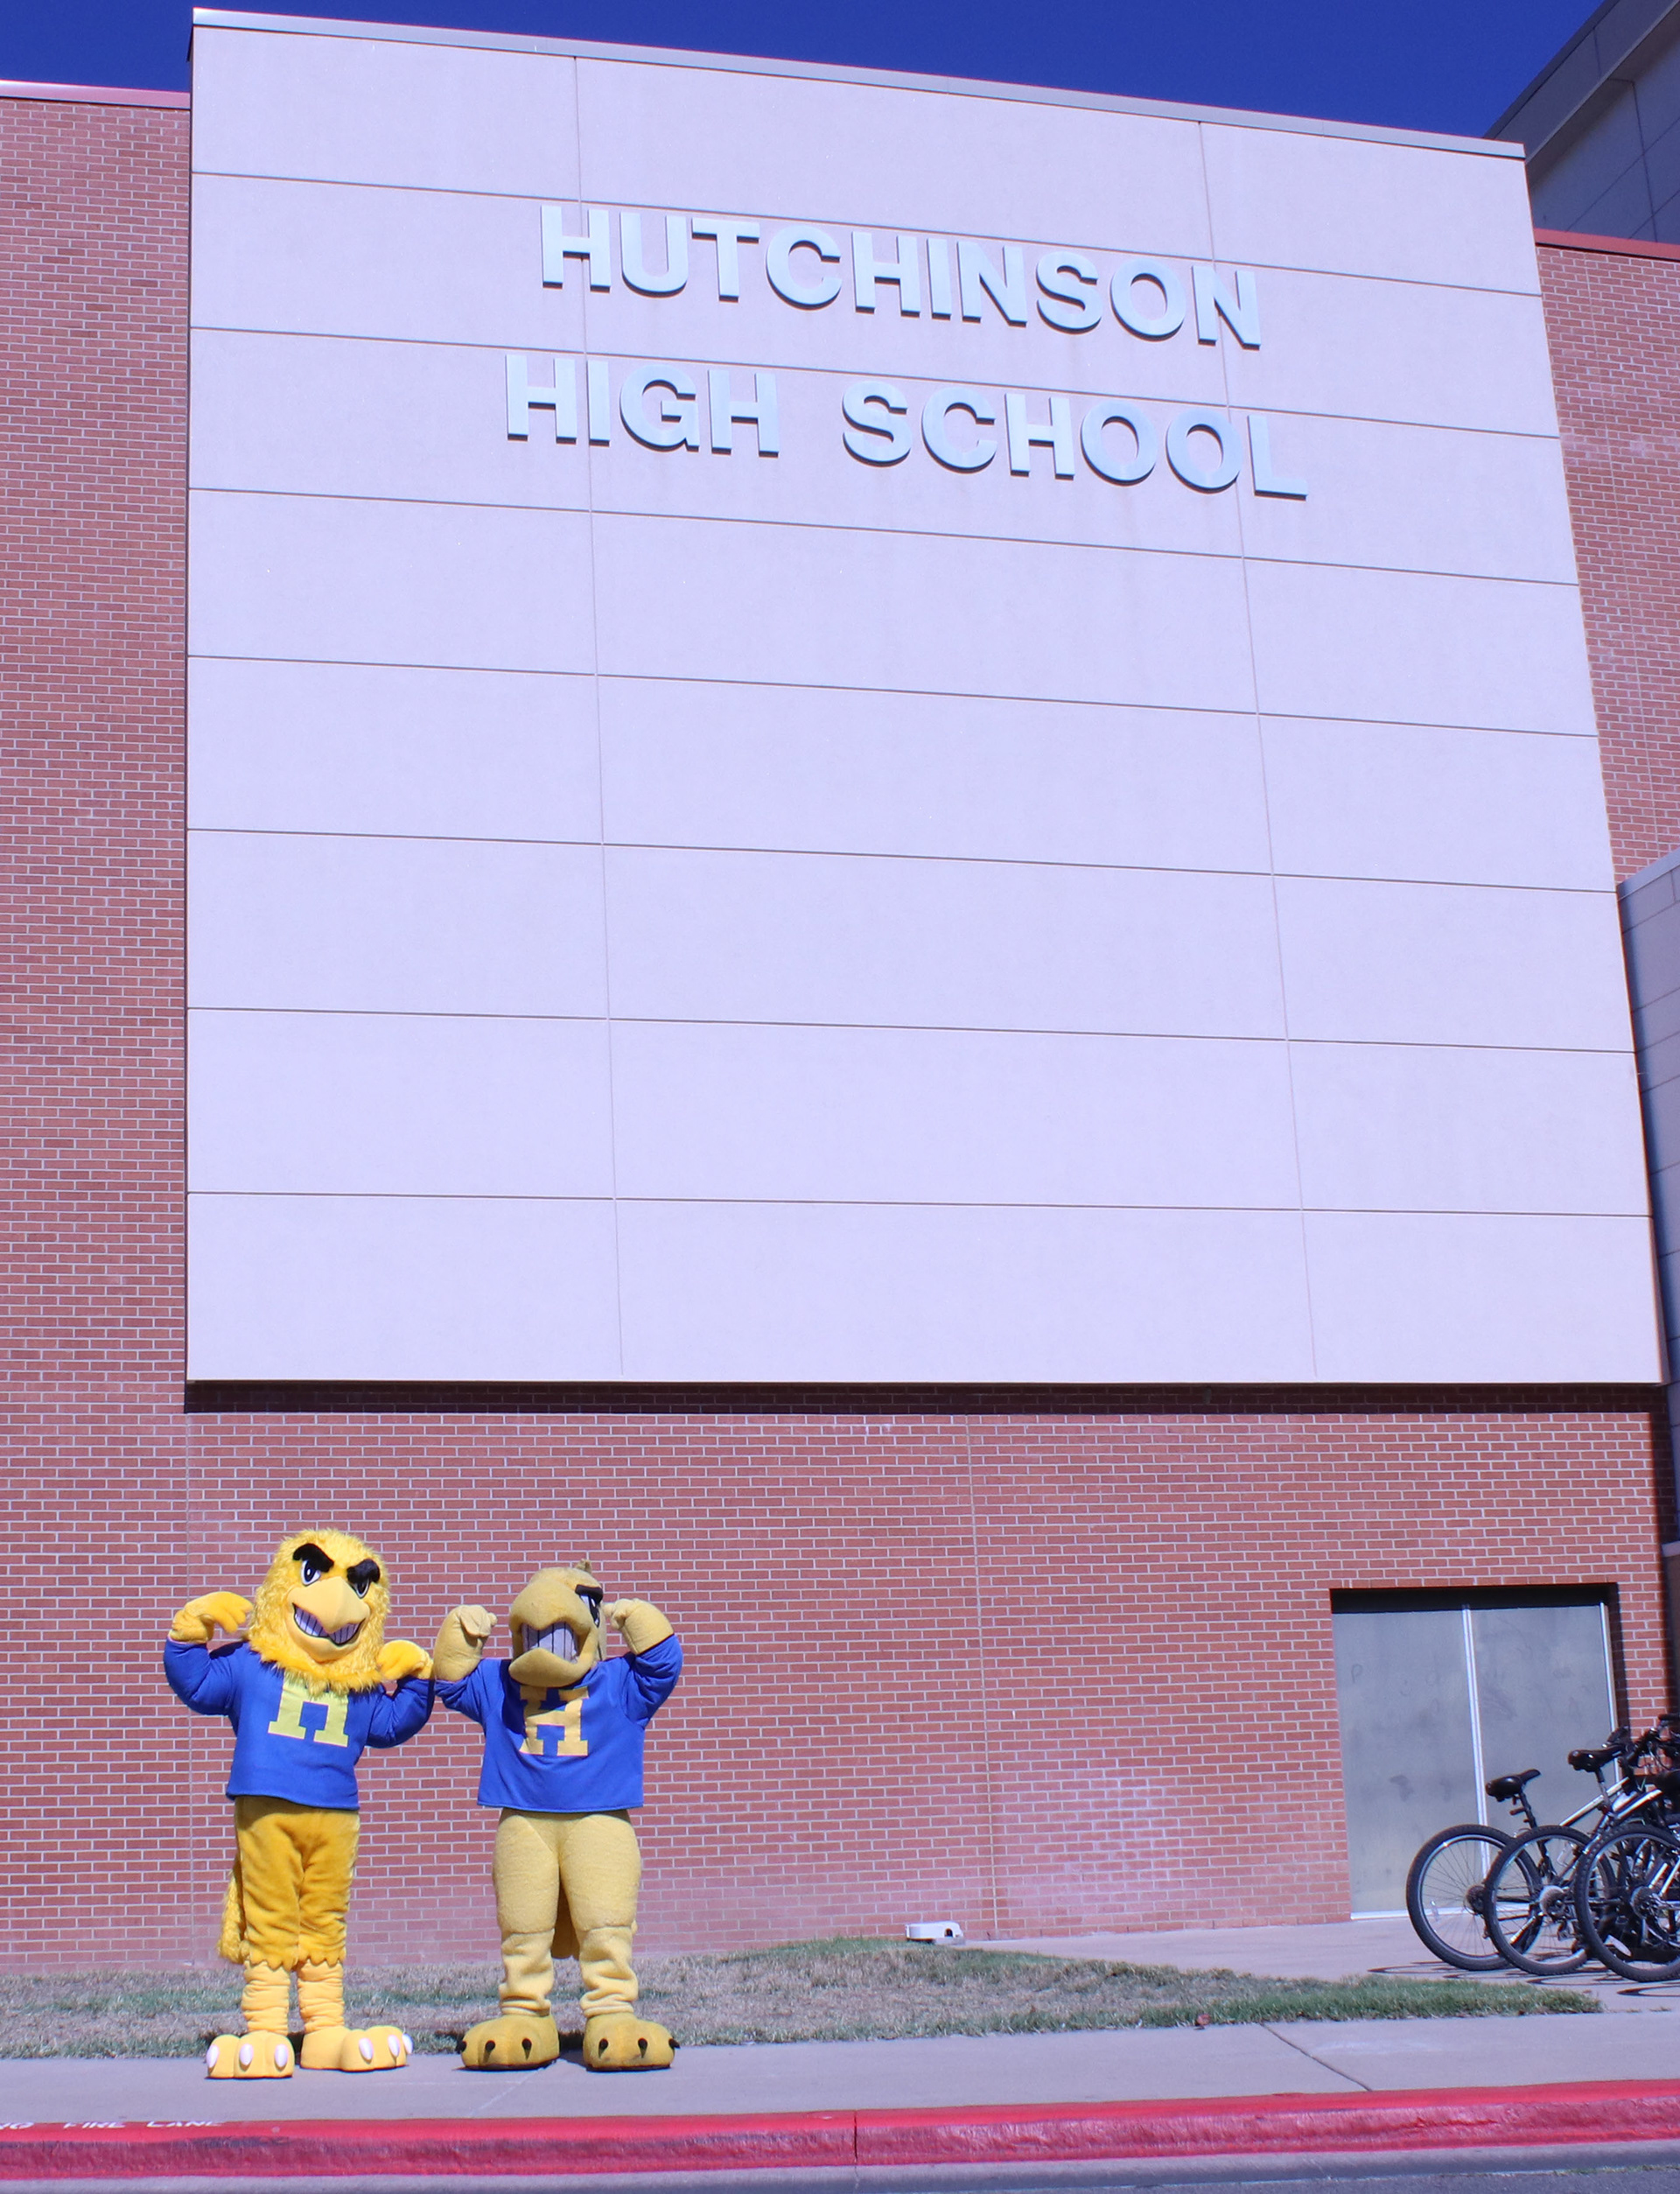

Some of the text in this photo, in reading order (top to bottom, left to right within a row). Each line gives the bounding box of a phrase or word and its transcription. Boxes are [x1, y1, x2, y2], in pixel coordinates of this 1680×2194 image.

[540, 205, 1261, 350] HUTCHINSON
[506, 354, 1308, 501] HIGH SCHOOL
[519, 1686, 589, 1756] H
